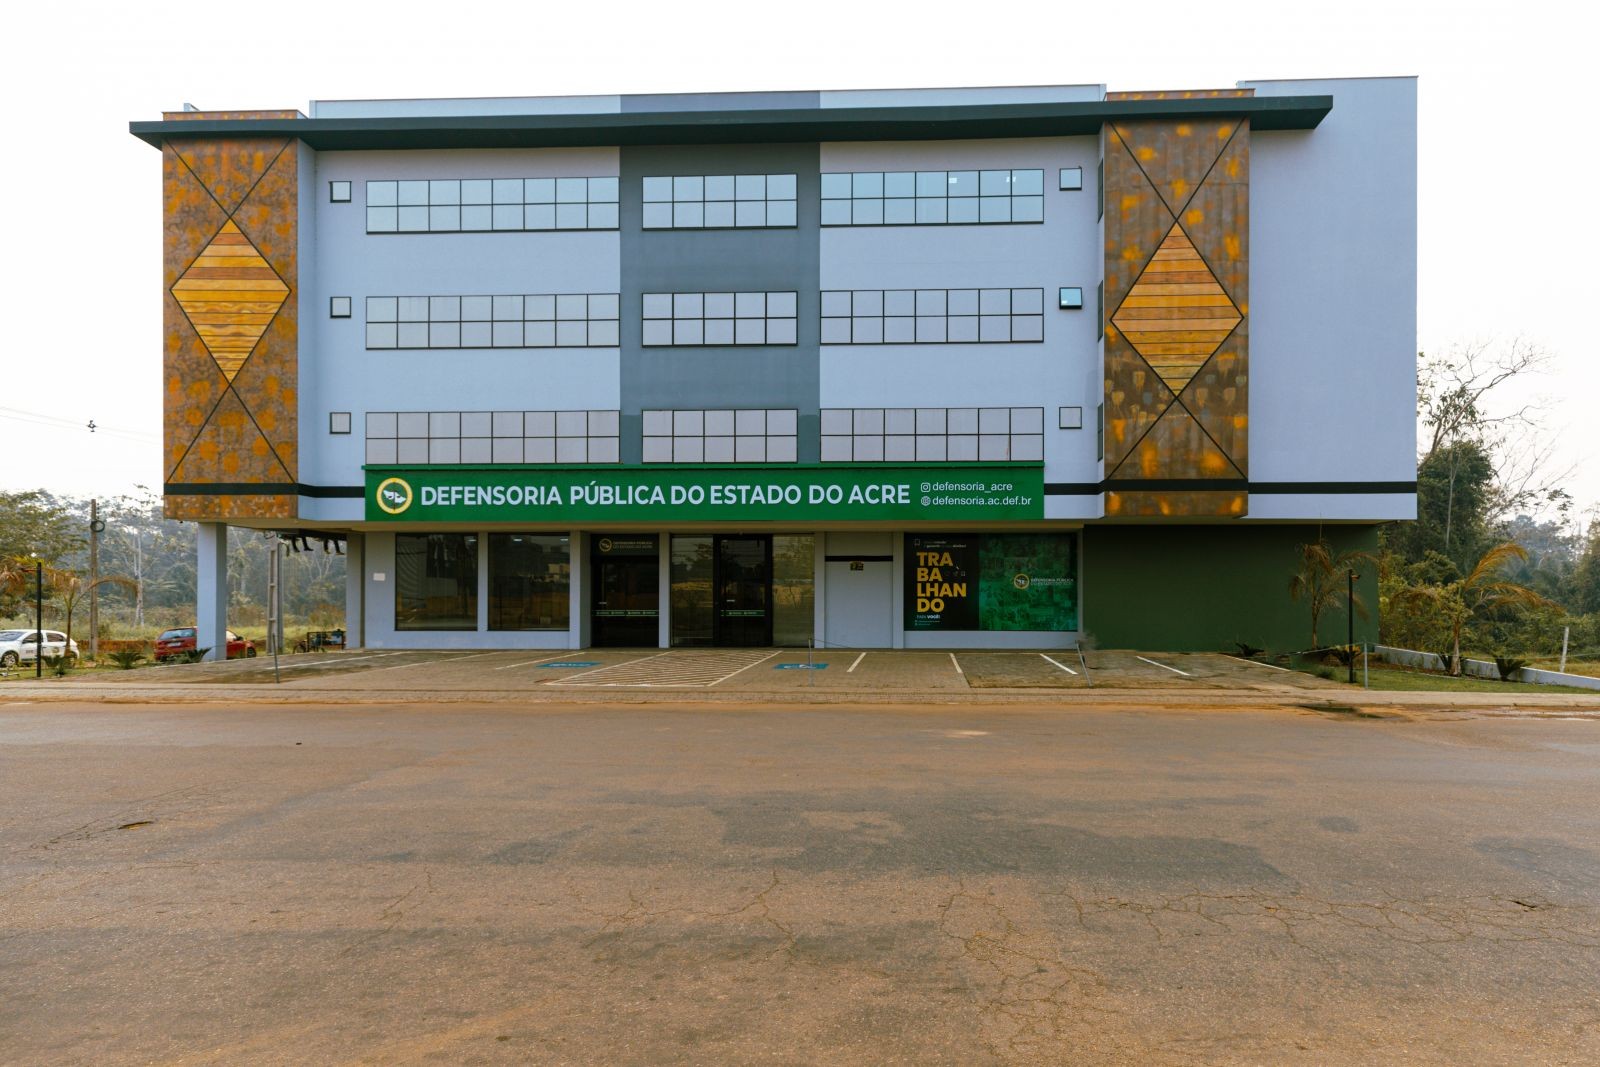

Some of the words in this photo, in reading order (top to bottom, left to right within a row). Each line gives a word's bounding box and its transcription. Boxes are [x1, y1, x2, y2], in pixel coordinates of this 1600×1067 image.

[421, 485, 563, 505] DEFENSORIA
[570, 480, 666, 505] PÚBLICA
[670, 485, 705, 505] DO
[710, 485, 802, 505] ESTADO
[808, 484, 844, 504] DO
[847, 484, 911, 504] ACRE
[932, 481, 1013, 493] defensoria_acre
[932, 495, 1032, 506] defensoria.ac.def.br
[917, 552, 954, 566] TRA
[917, 567, 943, 581] BA
[917, 583, 967, 597] LHAN
[917, 598, 945, 612] DO
